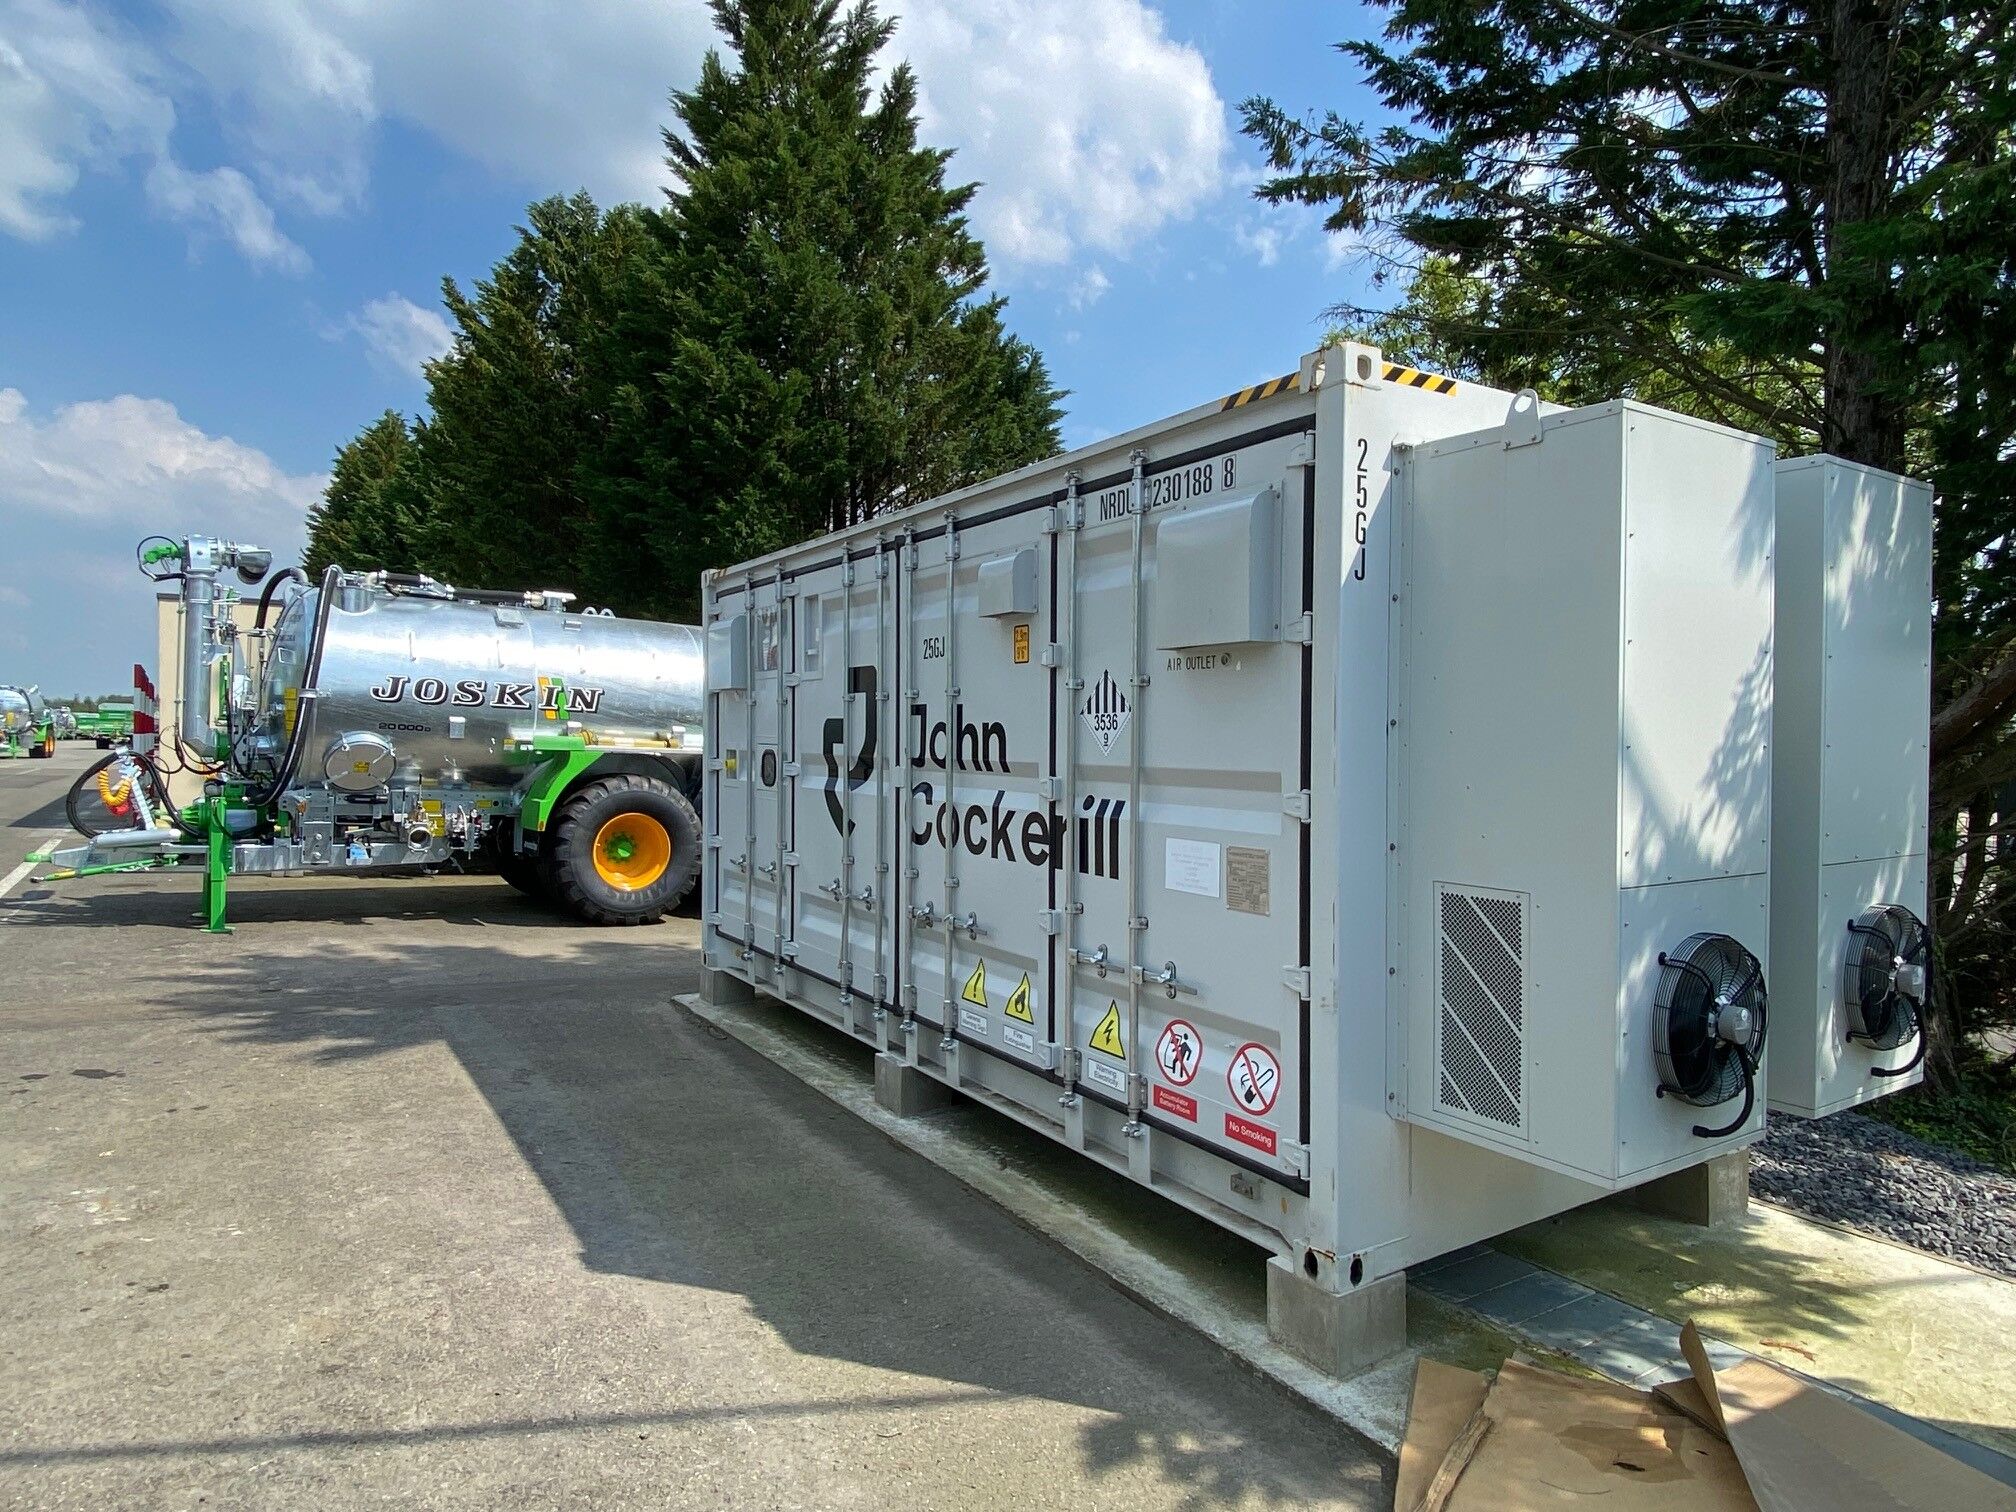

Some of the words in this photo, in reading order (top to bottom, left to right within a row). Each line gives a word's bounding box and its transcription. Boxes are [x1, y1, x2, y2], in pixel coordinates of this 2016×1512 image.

[1152, 464, 1212, 507] 230188
[1223, 457, 1235, 488] 8
[1354, 438, 1368, 580] 25GJ
[923, 636, 945, 660] 25GJ
[1167, 657, 1182, 671] AIR
[1185, 655, 1216, 670] OUTLET
[370, 675, 605, 713] JOSKIN
[911, 703, 1011, 773] John
[1094, 714, 1118, 732] 3536
[1103, 732, 1109, 744] 9
[911, 782, 1126, 880] Cockerill
[1229, 1120, 1240, 1132] No
[1240, 1125, 1272, 1148] Smoking
